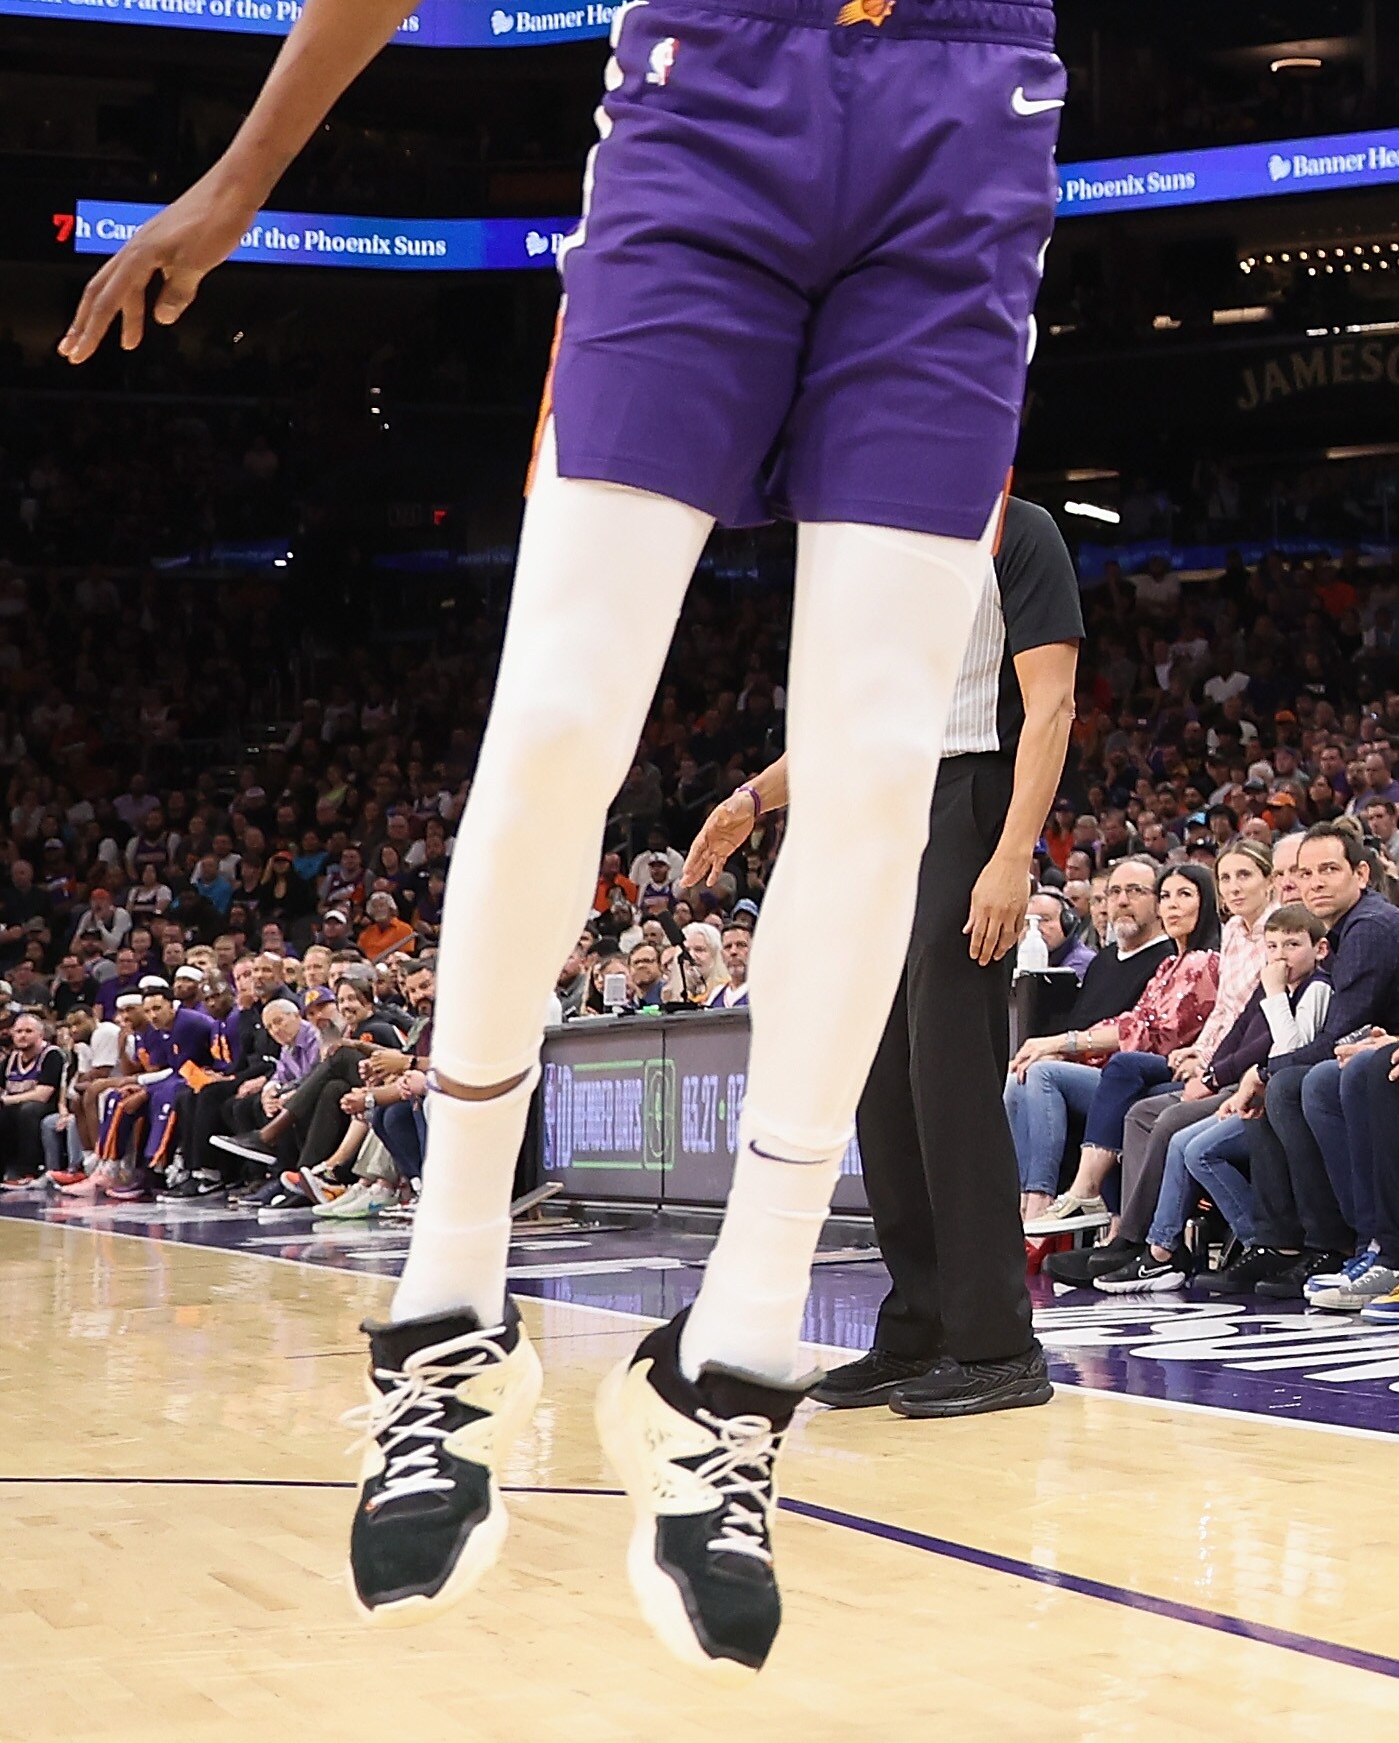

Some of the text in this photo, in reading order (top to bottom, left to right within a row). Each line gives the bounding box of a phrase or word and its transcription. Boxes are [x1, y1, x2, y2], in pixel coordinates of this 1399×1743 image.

[516, 9, 585, 33] Banner
[1293, 152, 1367, 179] Banner
[1066, 174, 1146, 202] Phoenix
[1146, 170, 1196, 194] Suns
[53, 213, 74, 242] 7
[95, 218, 144, 241] Car
[264, 228, 300, 251] the
[304, 229, 391, 256] Phoenix
[393, 234, 447, 257] Suns
